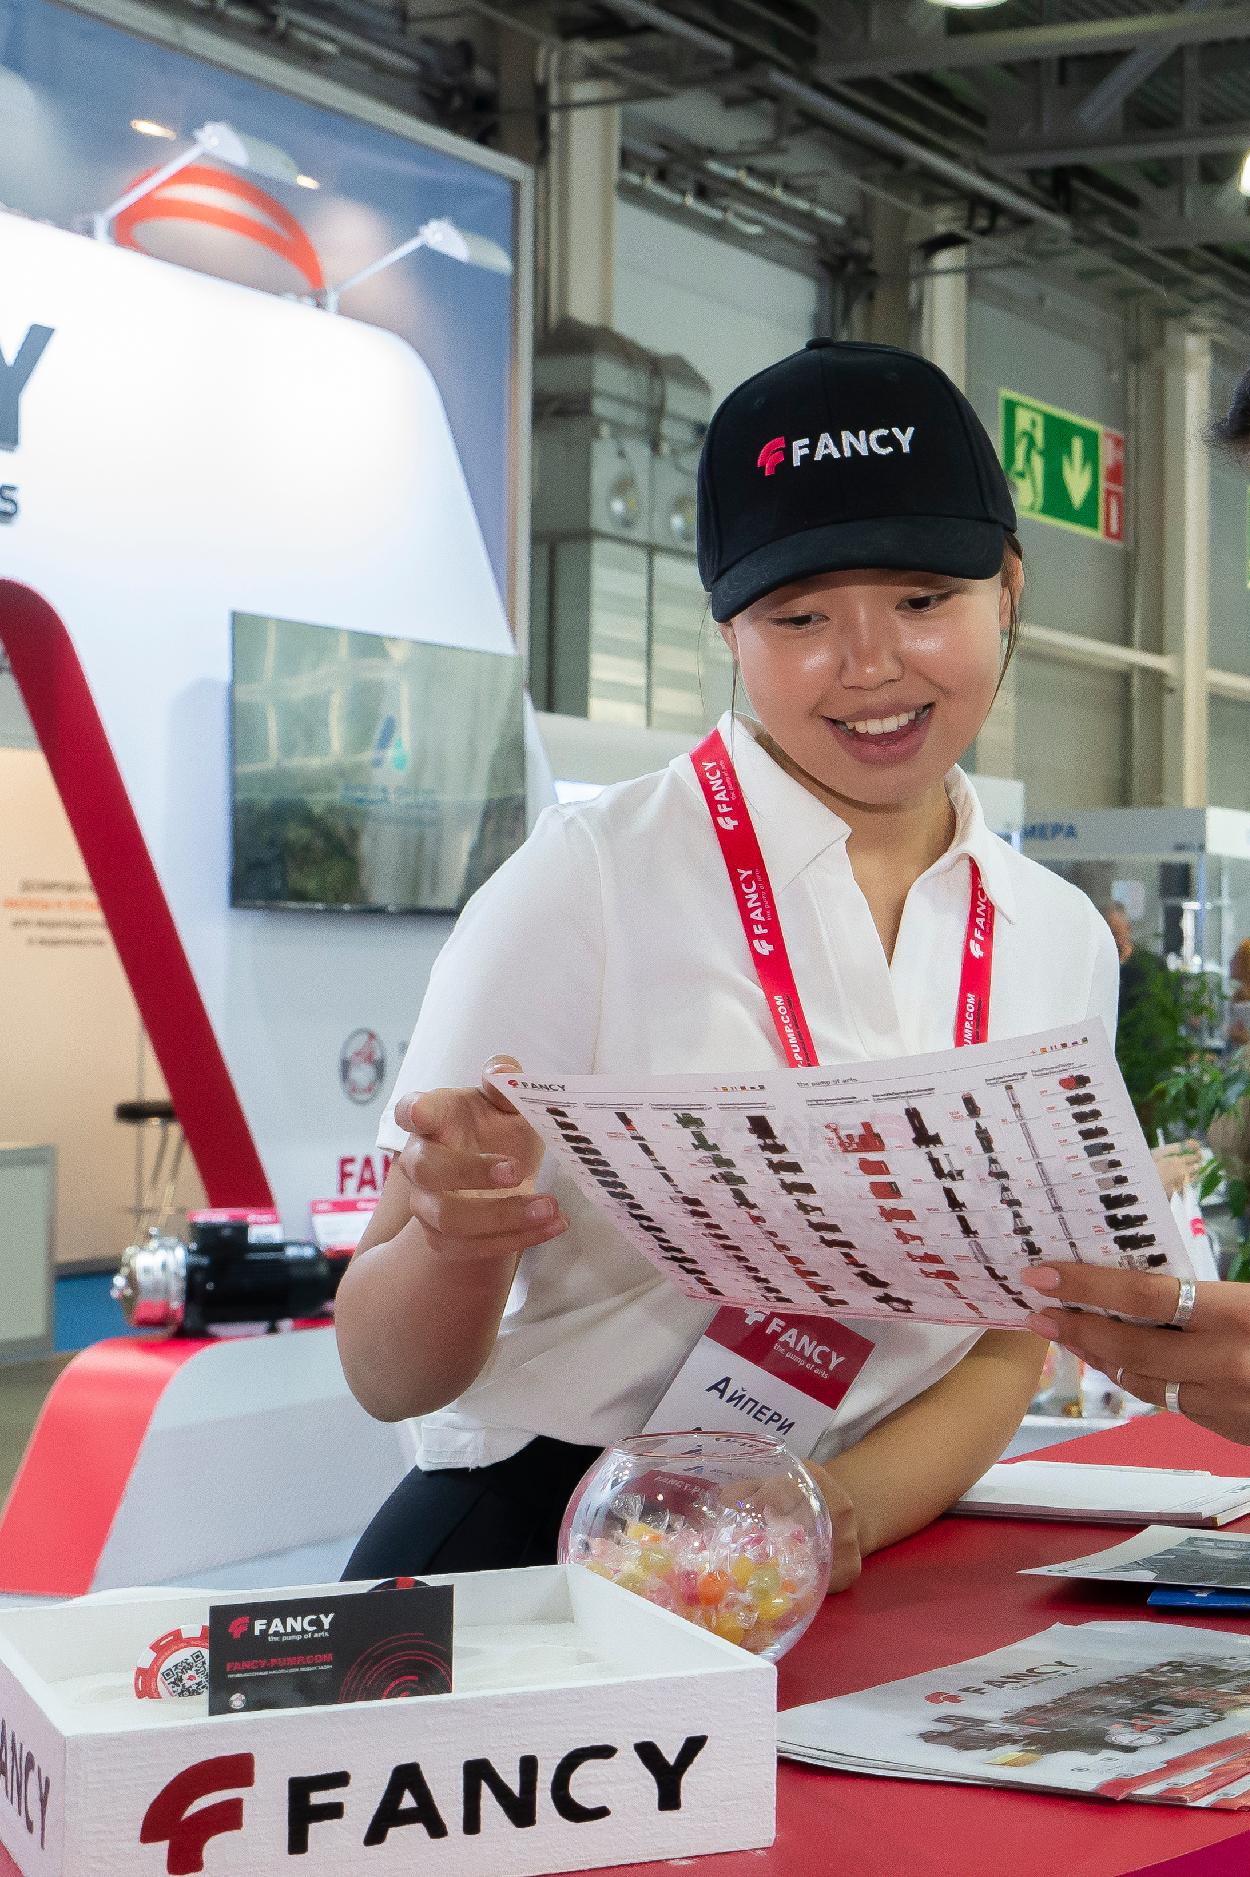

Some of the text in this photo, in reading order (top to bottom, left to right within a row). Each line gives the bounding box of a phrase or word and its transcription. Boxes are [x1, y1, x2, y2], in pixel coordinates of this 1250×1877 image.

[791, 426, 916, 467] FANCY
[701, 761, 733, 813] FANCY
[736, 868, 770, 934] FANCY
[520, 1081, 566, 1092] FANCY
[765, 1317, 846, 1371] FANCY
[773, 1342, 785, 1355] the
[785, 1352, 805, 1367] pump
[814, 1366, 829, 1379] arts
[705, 1376, 796, 1436] АЙПЕРИ
[254, 1612, 336, 1636] FANCY
[282, 1634, 301, 1642] pump
[956, 1660, 1078, 1695] FANCY
[287, 1735, 707, 1855] FANCY
